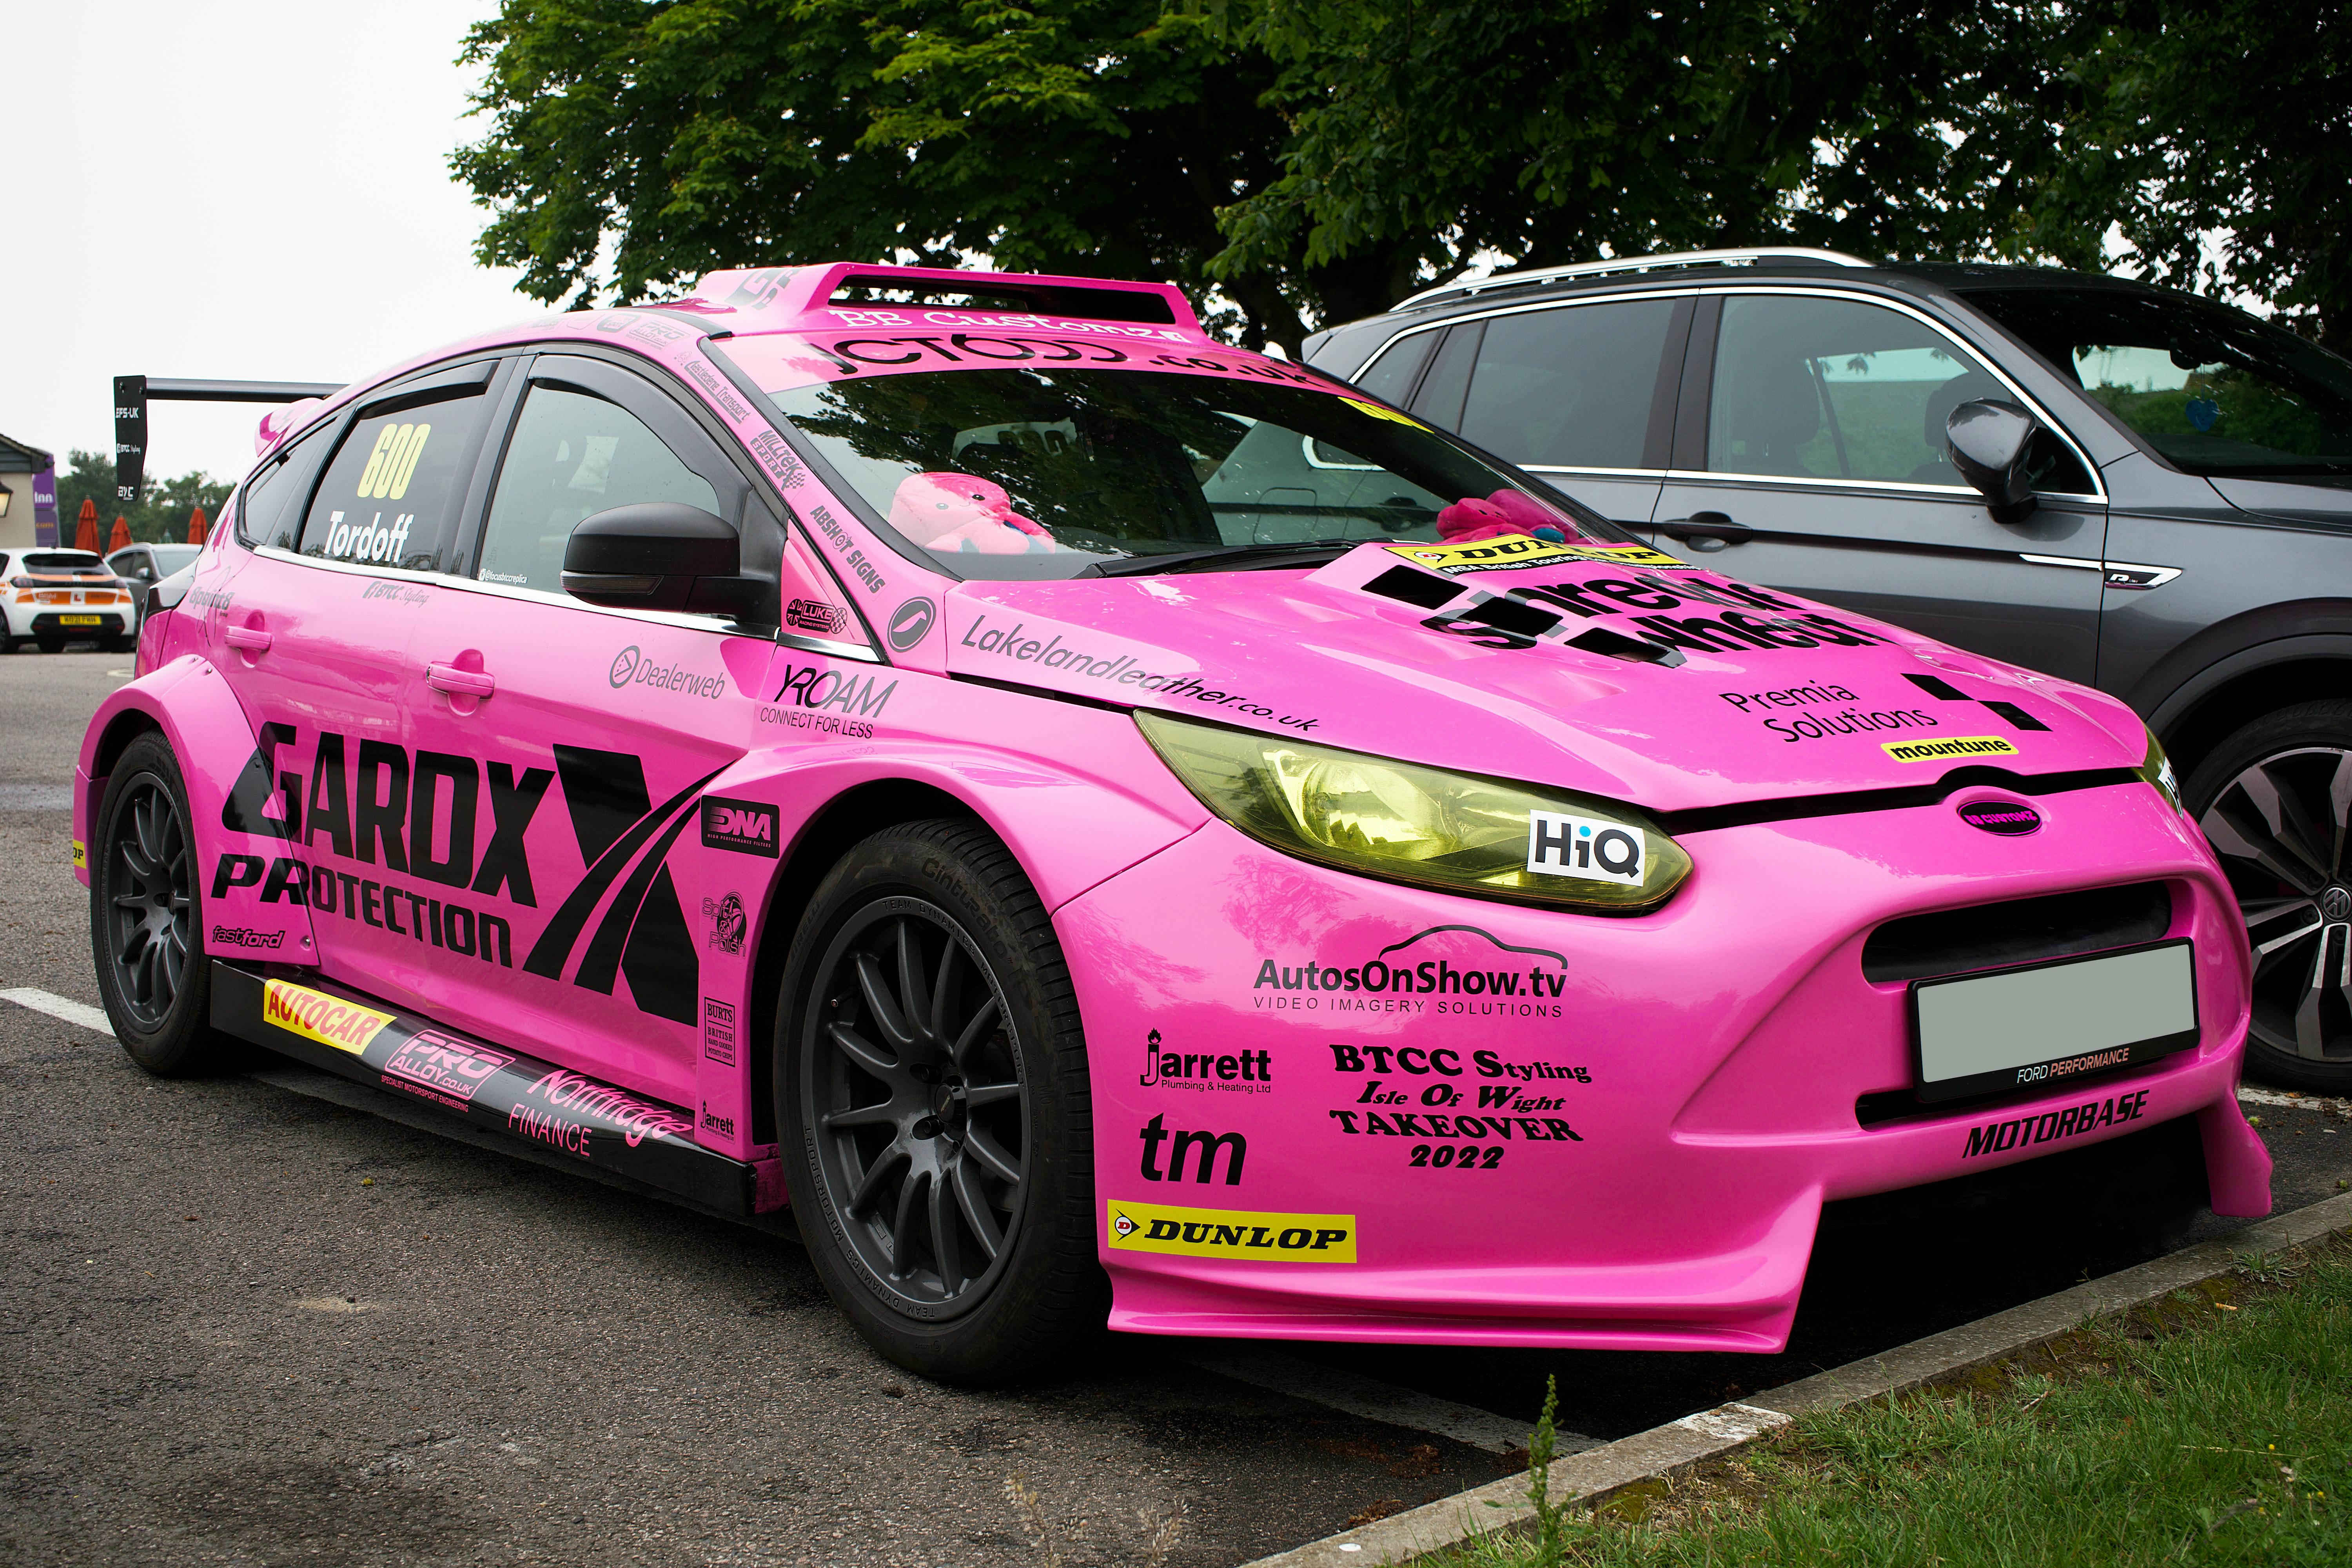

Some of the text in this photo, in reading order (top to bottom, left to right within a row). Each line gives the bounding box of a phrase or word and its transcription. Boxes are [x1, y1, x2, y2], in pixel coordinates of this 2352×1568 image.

[828, 310, 913, 327] BB
[116, 407, 139, 419] EFS-UK
[715, 386, 751, 421] Transport
[121, 444, 130, 453] BTCC
[357, 424, 431, 499] 600
[752, 441, 781, 475] SPORT
[34, 492, 53, 503] Inn
[324, 511, 414, 563] Tordoff
[810, 505, 886, 594] ABSHOT SIGNS
[1443, 564, 1480, 574] MSA
[1481, 561, 1530, 570] British
[1530, 554, 1585, 565] Touring
[374, 584, 430, 608] BTCC Styling
[803, 604, 834, 621] LUKE
[635, 659, 725, 699] Dealerweb
[962, 615, 1321, 732] Lakelandleather.co.uk
[1719, 680, 1860, 713] Premia
[760, 707, 873, 739] CONNECT FOR LESS
[1763, 708, 1938, 743] Solutions
[1890, 739, 2011, 760] mountune
[222, 720, 557, 909] GARDX
[708, 806, 771, 841] DNA
[1964, 810, 2038, 825] BB CUSTOMZ
[720, 835, 752, 845] PERFORMANCE
[753, 839, 771, 848] FILTERS
[1535, 820, 1639, 878] HiQ
[211, 853, 514, 969] PROTECTION
[703, 897, 729, 920] Spit
[212, 926, 286, 949] fastford
[709, 931, 746, 957] Polish
[719, 920, 728, 935] &
[882, 899, 912, 912] TEAM
[919, 904, 976, 956] DYNAMICS
[981, 961, 1026, 1087] MOTORSPORT
[1254, 959, 1567, 998] AutosOnShow.tv
[268, 984, 381, 1046] AUTOCAR
[708, 1003, 732, 1023] BURTS
[1254, 996, 1563, 1018] VIDEO IMAGERY SOLUTIONS
[708, 1026, 733, 1042] BRITISH
[708, 1038, 733, 1051] HAND COOKED
[400, 1033, 503, 1079] PRO
[708, 1047, 733, 1060] POTATO CHIPS
[1140, 1043, 1272, 1087] jarrett
[1329, 1044, 1592, 1083] BTCC Styling
[2017, 1047, 2129, 1083] FORD PERFORMANCE
[389, 1055, 474, 1095] ALLOY.CO.UK
[1161, 1079, 1271, 1094] Plumbing & Heating Ltd
[381, 1074, 469, 1113] SPECIALIST MOTORSPORT ENGINEERING
[526, 1069, 694, 1147] Northridge
[1356, 1081, 1567, 1113] Isle Of Wight
[508, 1102, 593, 1157] FINANCE
[701, 1107, 734, 1136] jarrett
[1329, 1109, 1584, 1142] TAKEOVER
[1962, 1089, 2150, 1159] MOTORBASE
[1140, 1112, 1247, 1186] tm
[1408, 1144, 1504, 1169] 2022
[804, 1125, 844, 1243] MOTORSPORT
[1144, 1219, 1347, 1250] DUNLOP
[845, 1248, 900, 1308] DYNAMICS
[906, 1302, 935, 1318] TEAM
